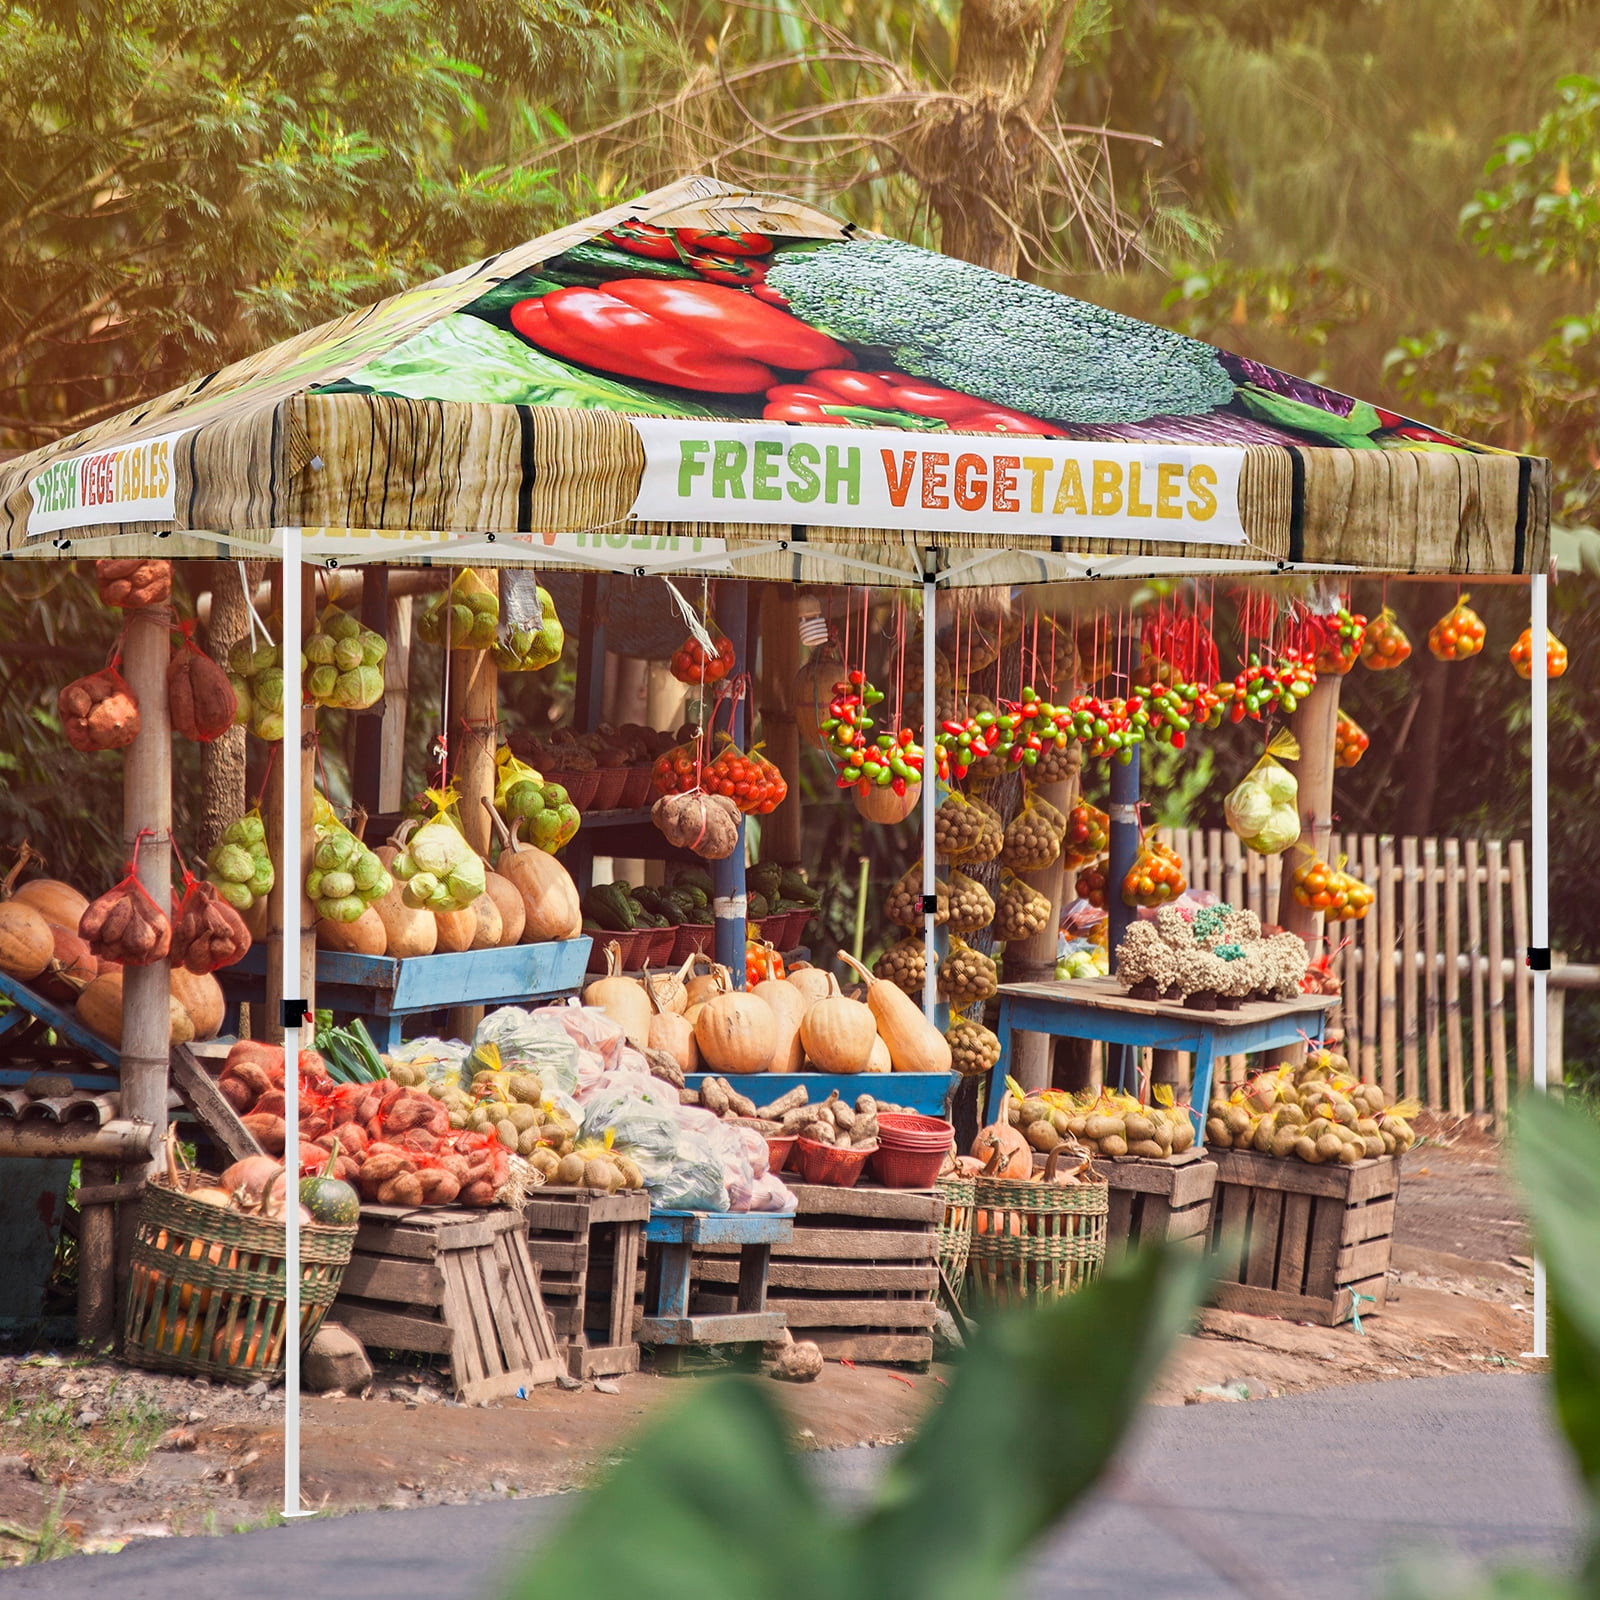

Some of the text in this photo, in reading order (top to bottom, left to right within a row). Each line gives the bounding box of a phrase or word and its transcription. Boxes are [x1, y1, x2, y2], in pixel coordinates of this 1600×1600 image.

[36, 441, 169, 514] FRESH VEGETABLES
[678, 440, 1218, 521] FRESH VEGETABLES
